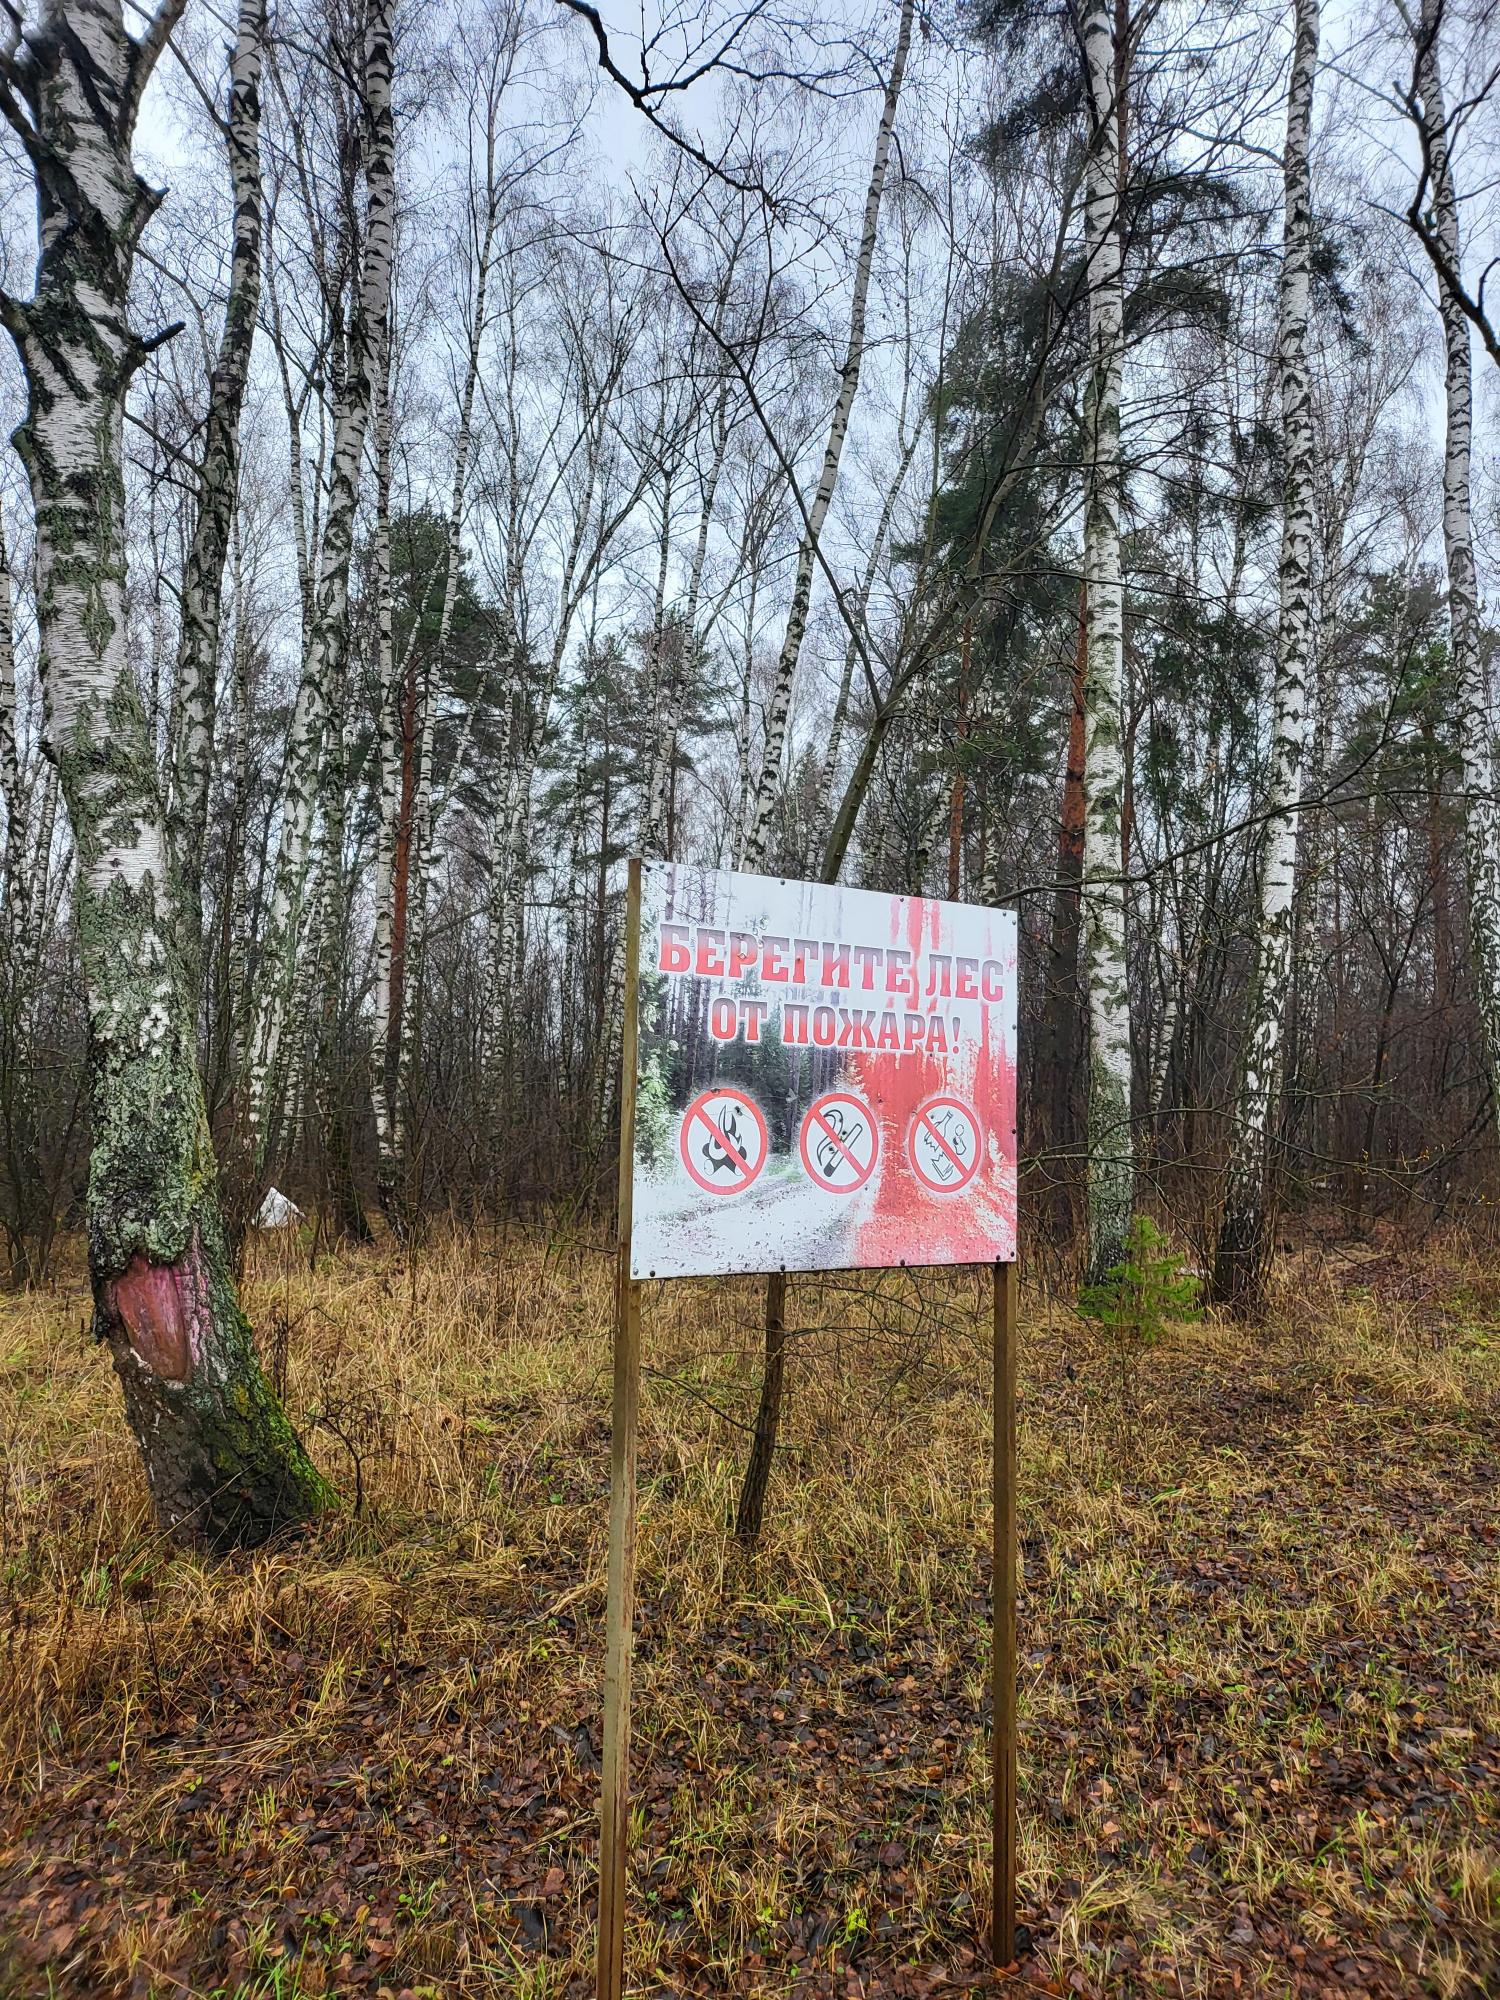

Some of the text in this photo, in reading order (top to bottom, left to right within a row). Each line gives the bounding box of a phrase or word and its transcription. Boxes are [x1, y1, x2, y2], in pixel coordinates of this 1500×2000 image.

[658, 923, 1004, 1002] БЕРЕГИТЕ ЛЕС
[711, 997, 961, 1054] ОТ ПОЖАРА!
